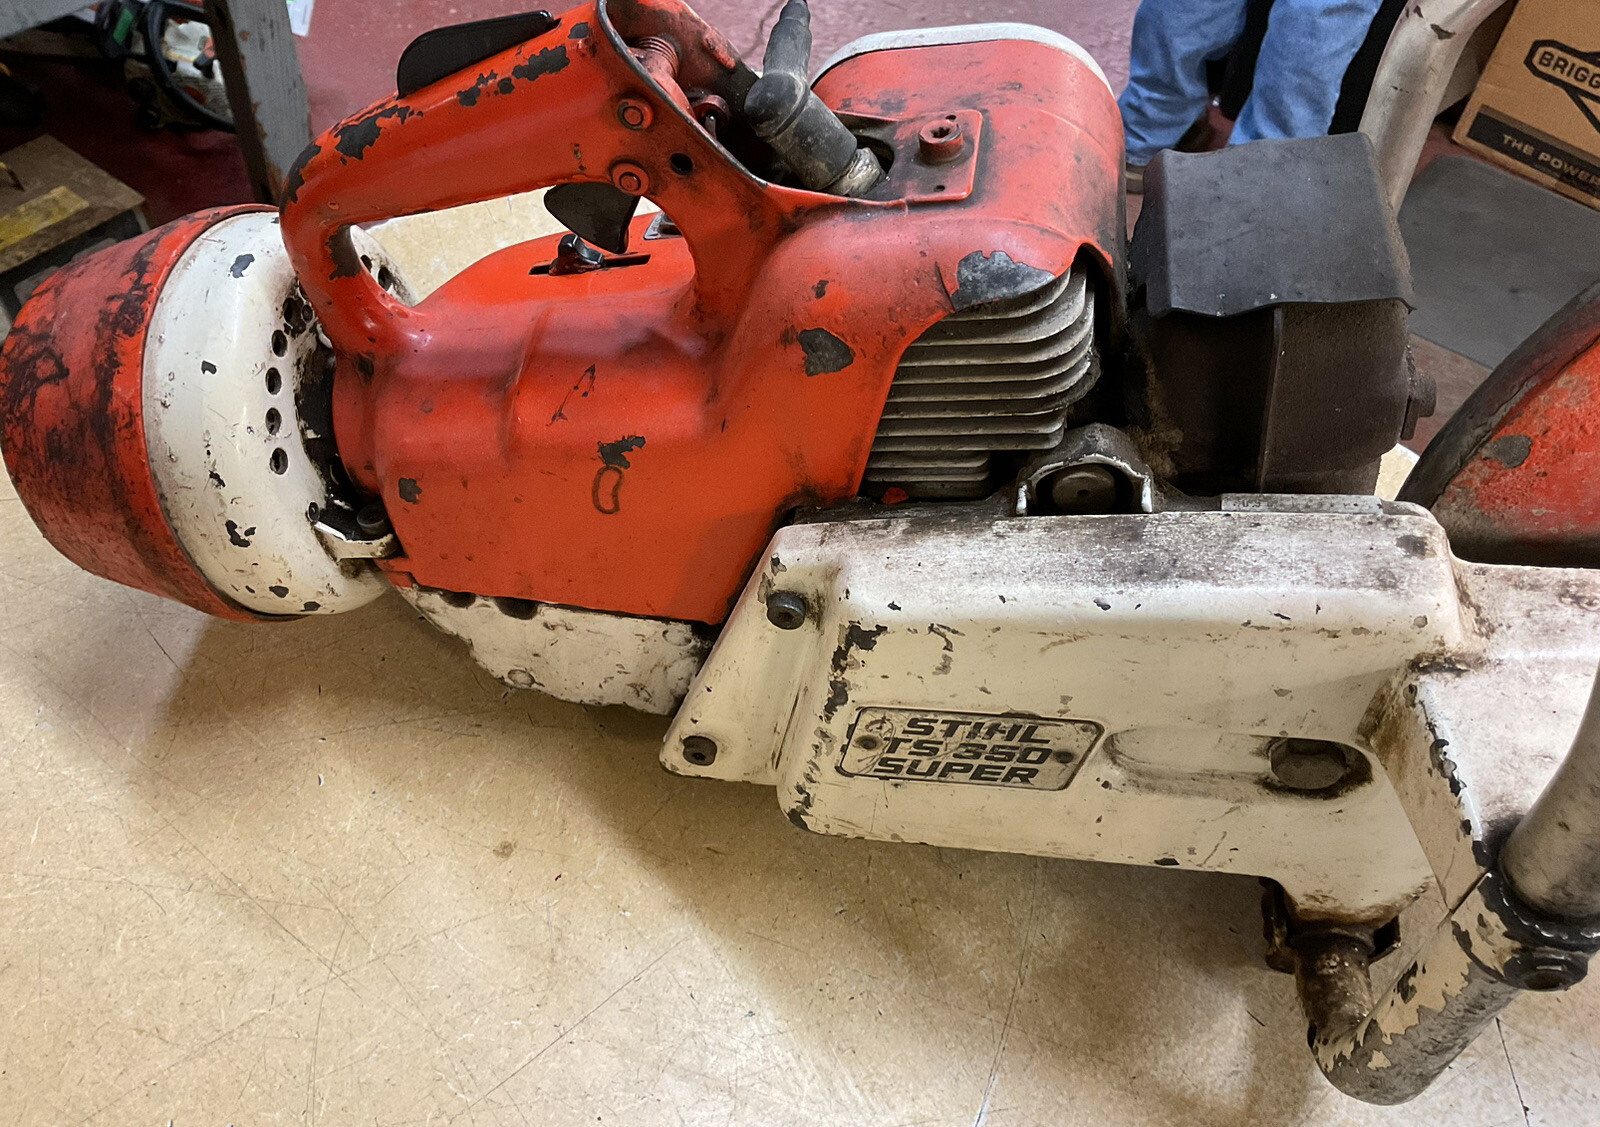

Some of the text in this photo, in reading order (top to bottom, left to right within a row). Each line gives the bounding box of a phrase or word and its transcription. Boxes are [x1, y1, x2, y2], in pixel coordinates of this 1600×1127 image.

[1539, 51, 1600, 89] BRIGG
[1503, 134, 1600, 187] THE POWER
[902, 717, 1051, 744] STIHL
[883, 737, 1053, 765] TS 350
[873, 757, 1039, 785] SUPER
